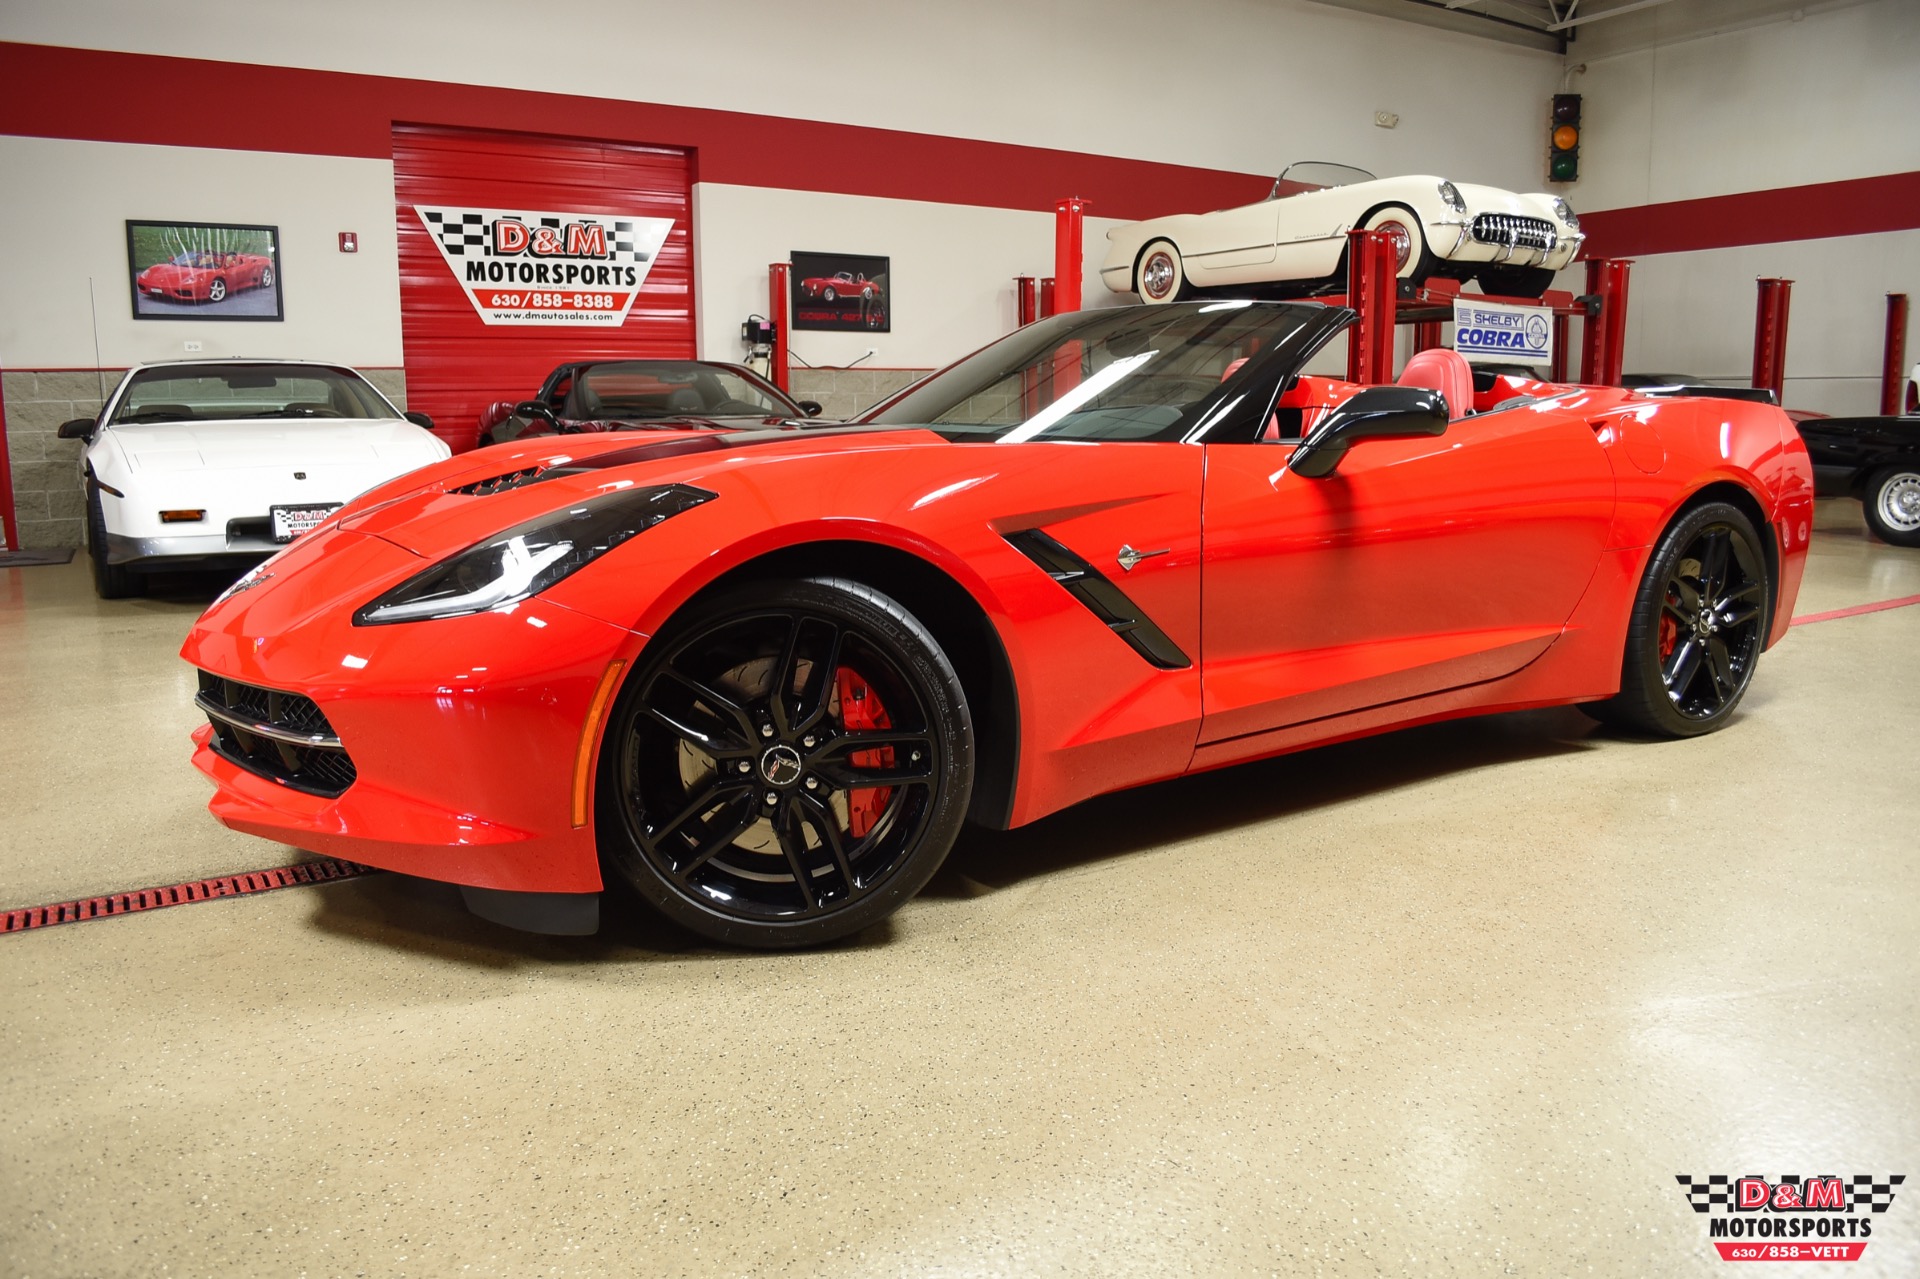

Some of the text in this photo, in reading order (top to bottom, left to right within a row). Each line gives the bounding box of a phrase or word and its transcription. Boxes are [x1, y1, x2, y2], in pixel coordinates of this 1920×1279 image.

[492, 219, 609, 260] D&M
[466, 261, 637, 287] MOTORSPORTS
[491, 291, 614, 309] 630/858-8388
[493, 311, 614, 322] www.dmautosales.com
[1474, 313, 1521, 328] SHELBY
[1456, 328, 1526, 348] COBRA
